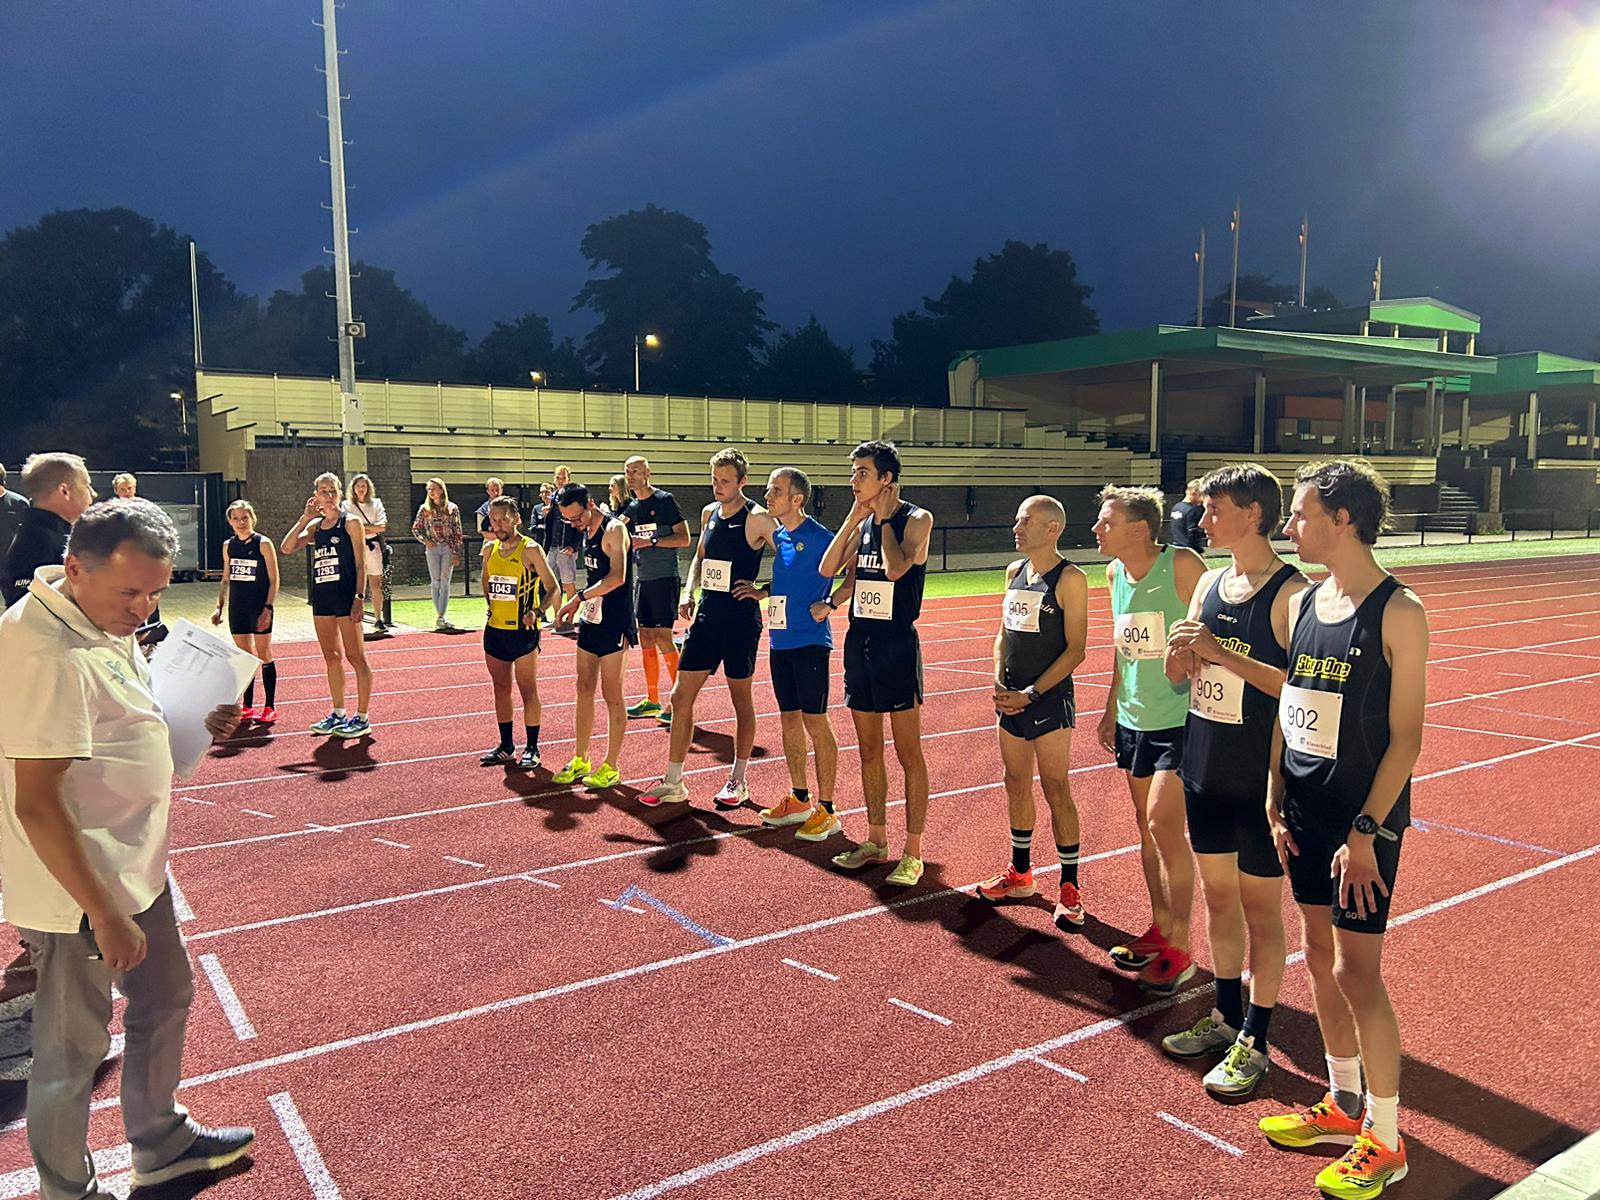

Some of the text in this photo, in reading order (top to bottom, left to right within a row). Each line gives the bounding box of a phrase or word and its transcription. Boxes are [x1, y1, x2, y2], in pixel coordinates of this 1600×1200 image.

[857, 554, 887, 570] MIL
[231, 565, 252, 575] 1294
[316, 565, 335, 577] 1293
[706, 568, 722, 580] 908
[490, 583, 512, 594] 1043
[860, 591, 881, 606] 906
[768, 605, 777, 617] 07
[1008, 601, 1029, 617] 905
[1123, 626, 1150, 643] 904
[1196, 678, 1224, 701] 903
[1287, 704, 1319, 732] 902
